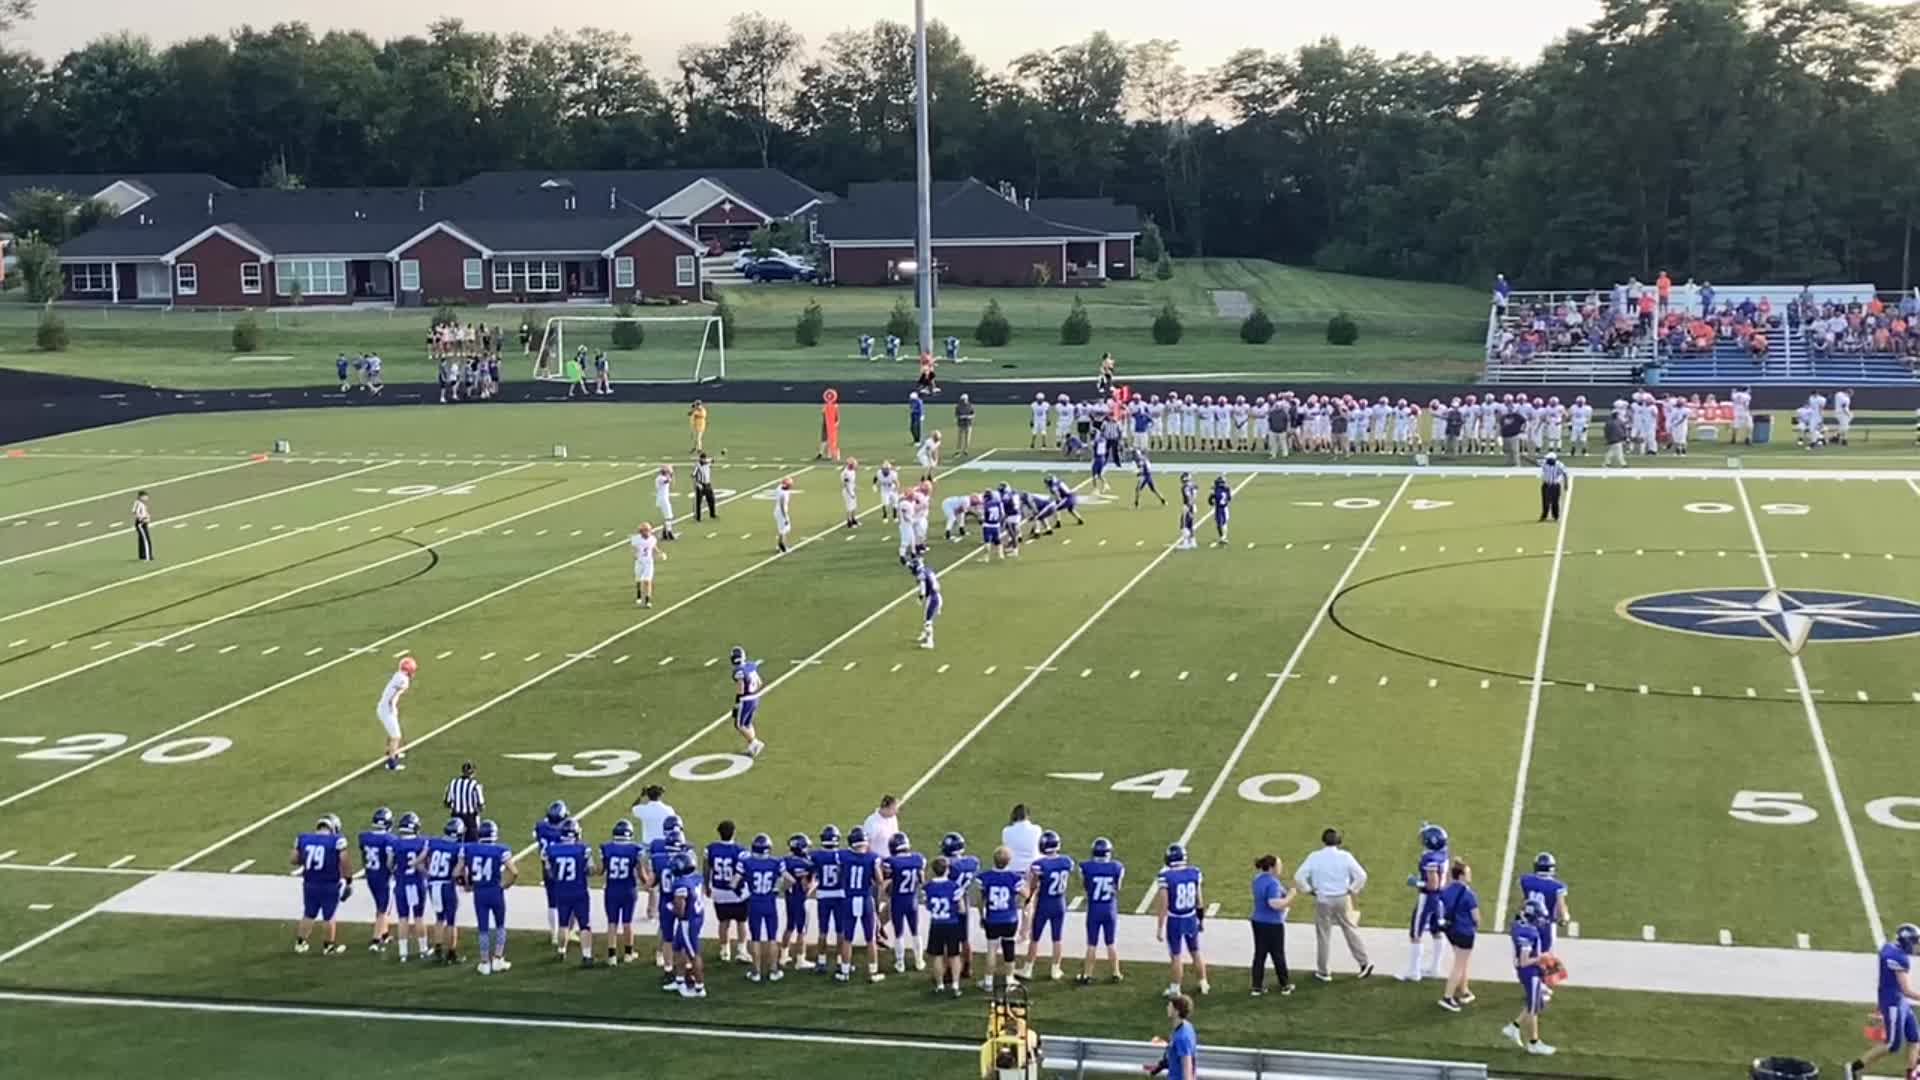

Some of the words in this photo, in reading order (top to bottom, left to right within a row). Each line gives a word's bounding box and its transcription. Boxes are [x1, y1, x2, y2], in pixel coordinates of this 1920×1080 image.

[304, 844, 325, 870] 79
[430, 849, 452, 878] 85
[471, 855, 493, 881] 54
[556, 856, 577, 881] 73
[608, 855, 630, 879] 55
[752, 871, 774, 895] 36
[822, 864, 839, 887] 15
[849, 864, 865, 889] 11
[898, 868, 917, 893] 21
[1092, 875, 1114, 901] 75
[929, 896, 952, 919] 22
[1175, 881, 1197, 909] 88
